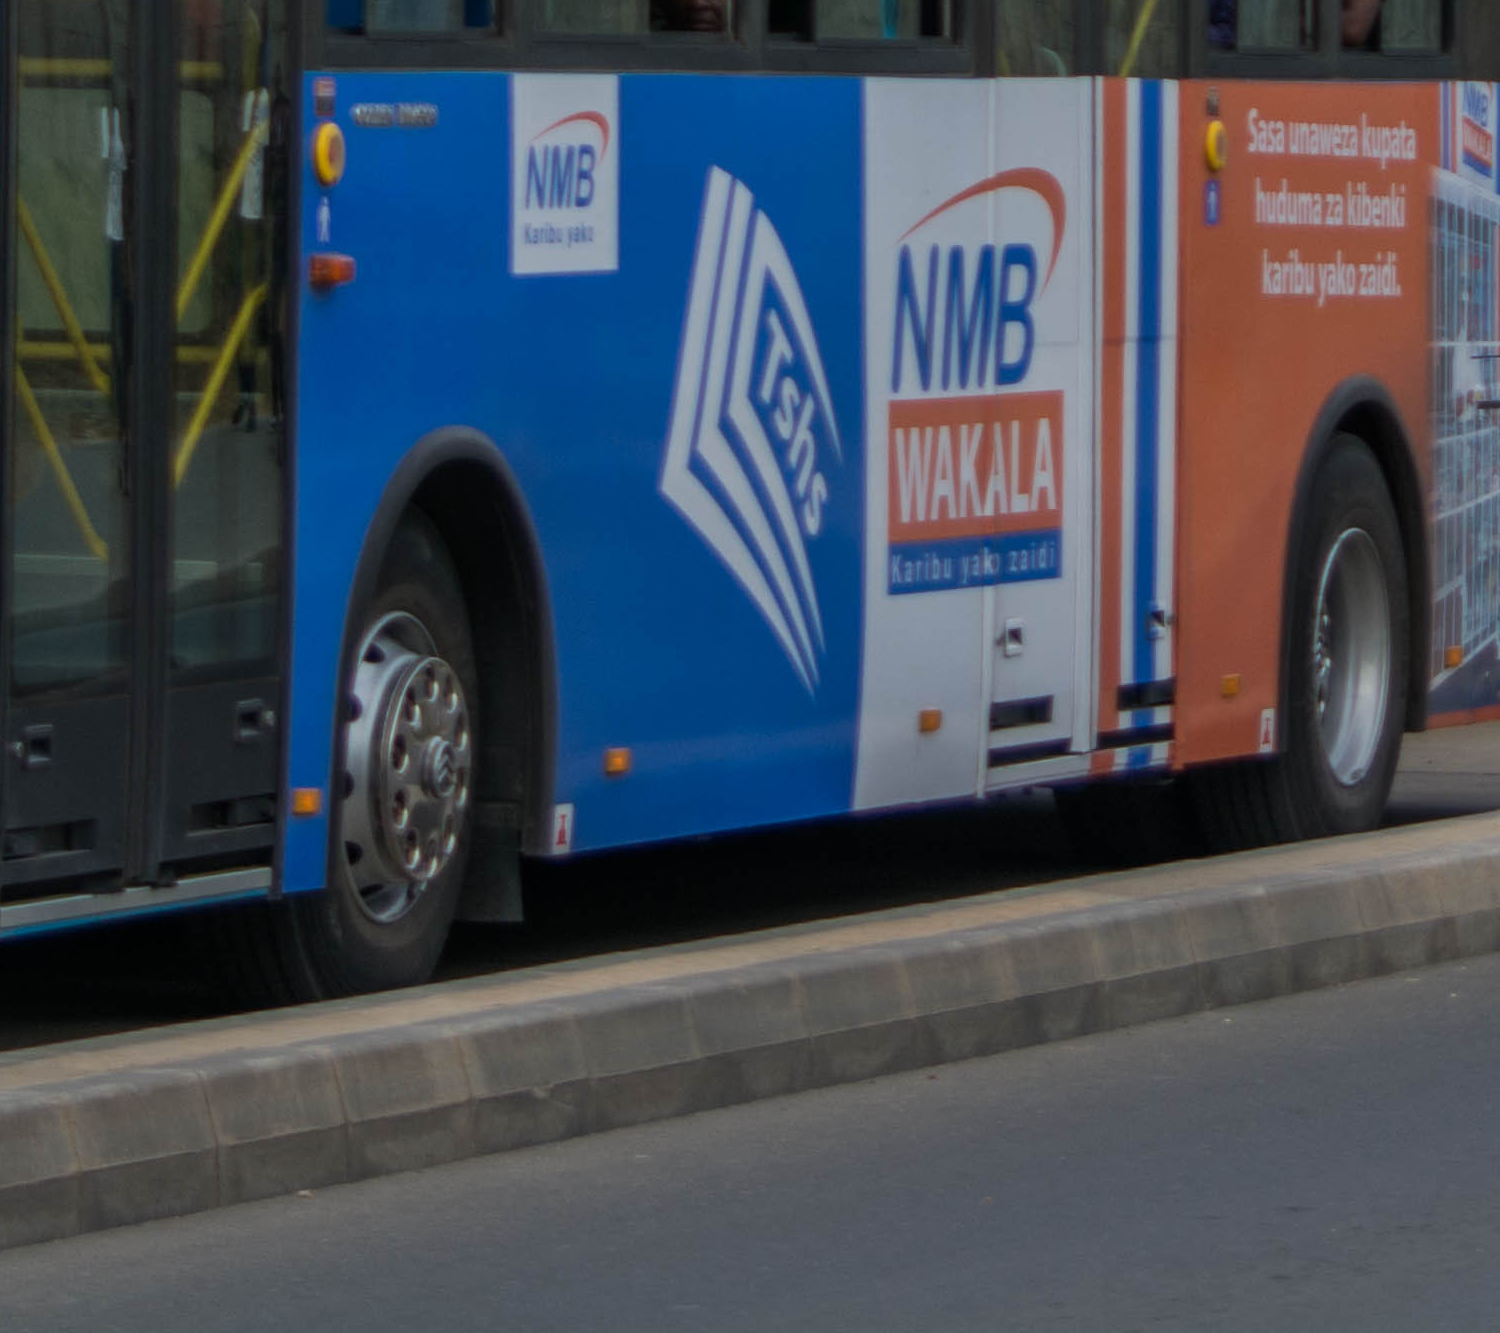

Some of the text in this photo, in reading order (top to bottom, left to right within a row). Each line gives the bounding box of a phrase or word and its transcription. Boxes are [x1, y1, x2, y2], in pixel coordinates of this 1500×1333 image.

[1248, 107, 1285, 153] Sasa
[1288, 121, 1359, 157] unaweza
[1361, 112, 1417, 170] kupata
[524, 143, 596, 210] NMB
[1255, 176, 1406, 228] huduma za kibenki
[524, 222, 563, 245] Karibu
[1262, 248, 1403, 308] karibu yako zaidi.
[891, 242, 1038, 394] NMB
[761, 308, 828, 536] Tshs
[894, 417, 1058, 524] WAKALA
[891, 552, 954, 584] Karibu
[1009, 540, 1056, 573] zaidi
